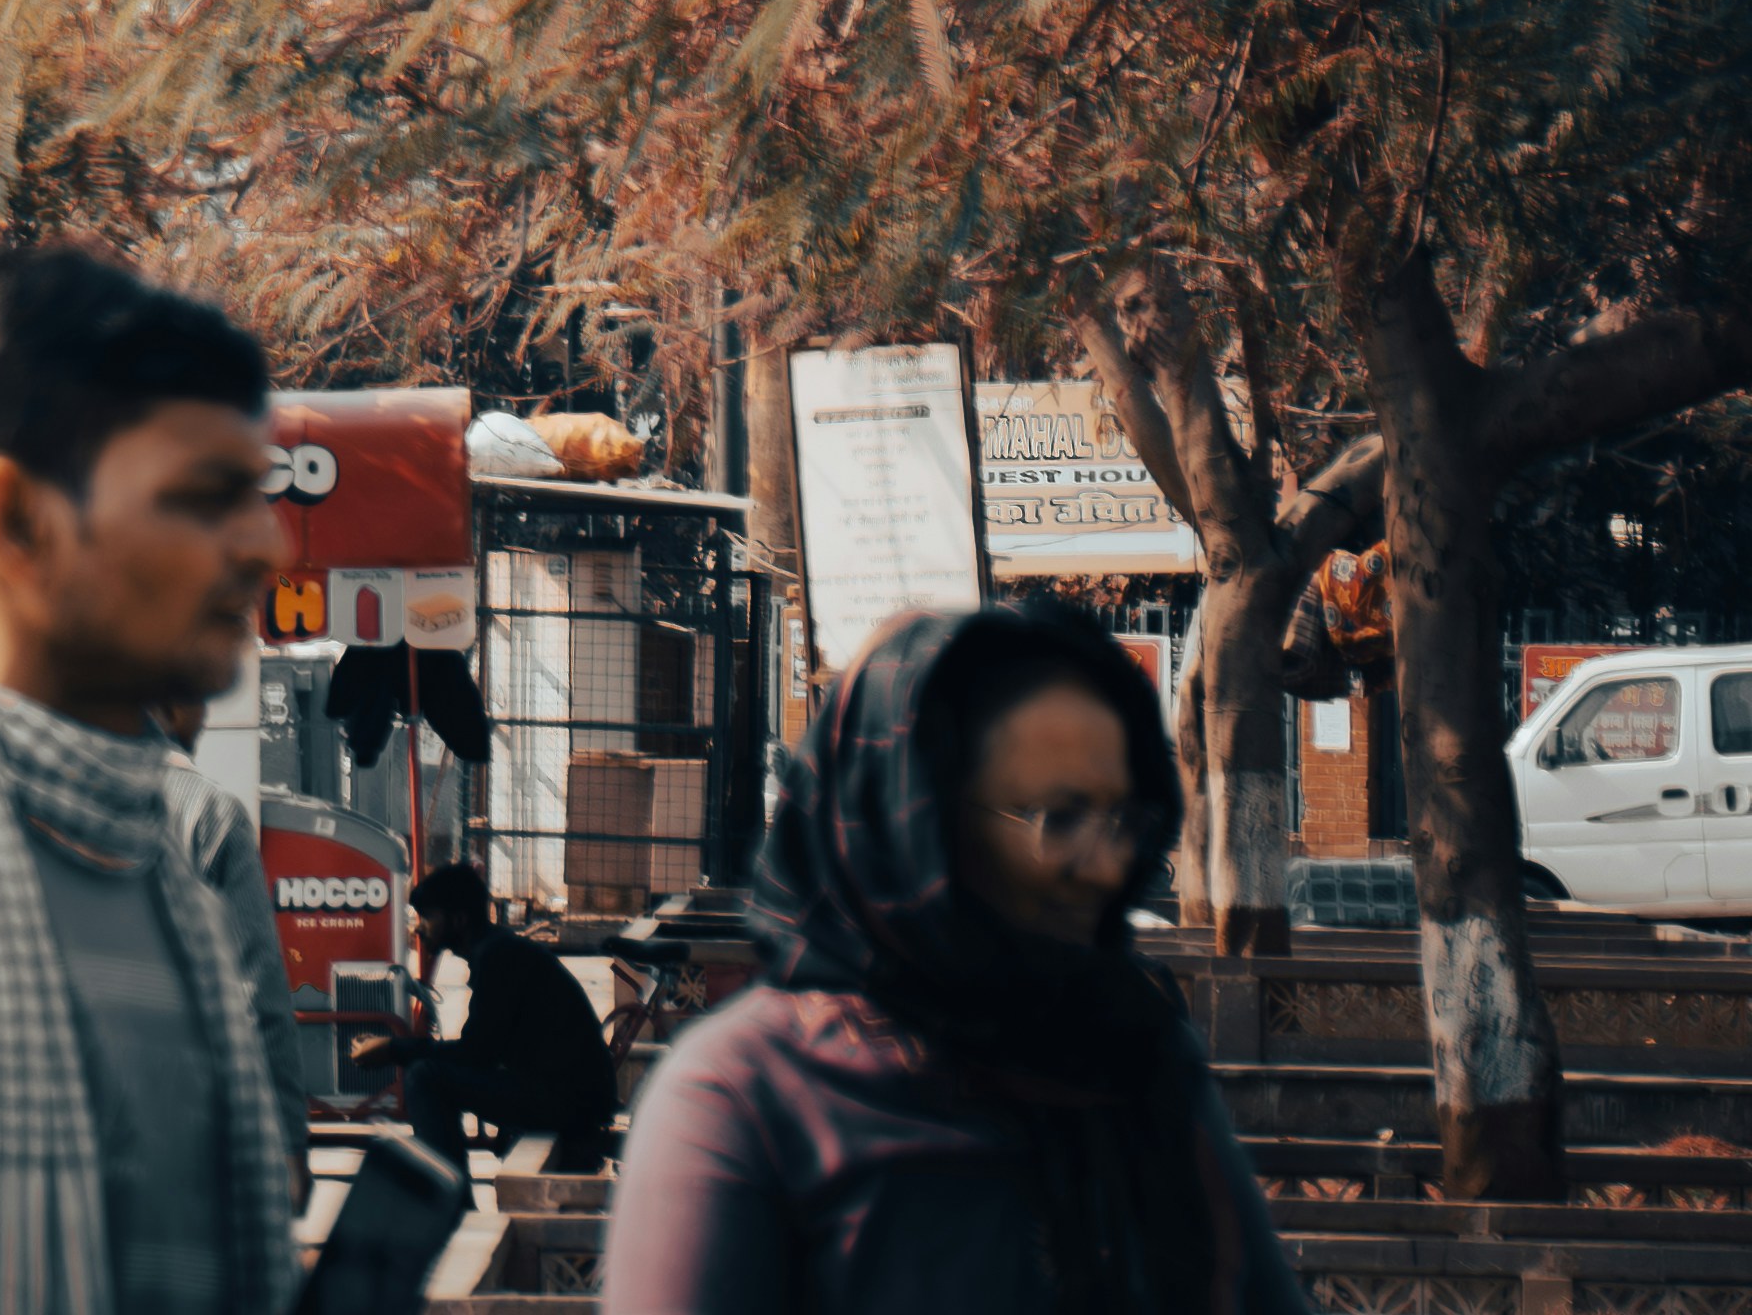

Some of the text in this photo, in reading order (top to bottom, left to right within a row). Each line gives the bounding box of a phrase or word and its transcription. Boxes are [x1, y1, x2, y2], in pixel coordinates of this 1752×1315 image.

[985, 414, 1092, 460] MAHAL
[1050, 492, 1159, 525] उचित
[276, 877, 390, 912] HOCCO
[296, 917, 365, 928] ICE CREAM
